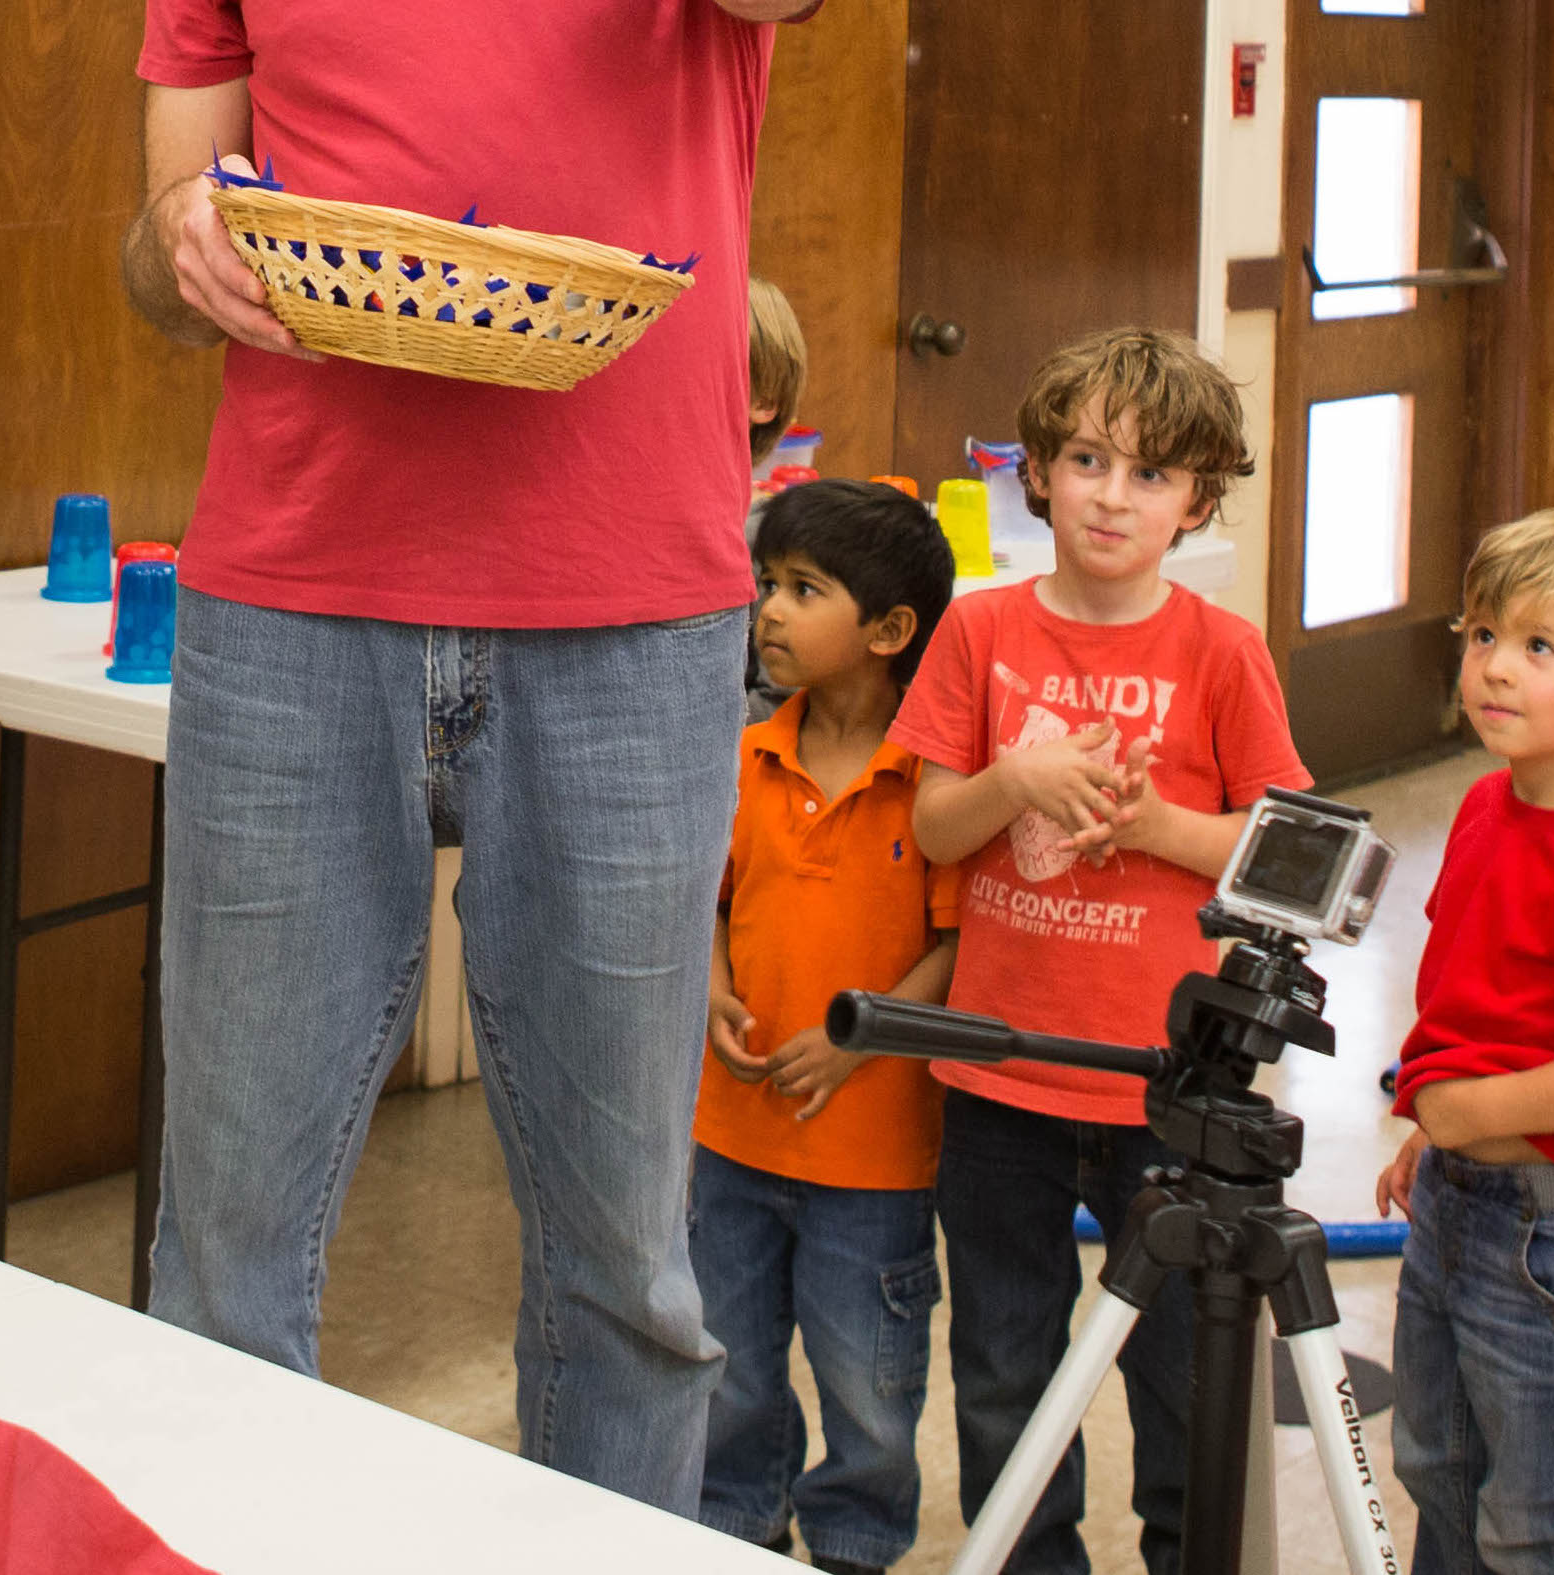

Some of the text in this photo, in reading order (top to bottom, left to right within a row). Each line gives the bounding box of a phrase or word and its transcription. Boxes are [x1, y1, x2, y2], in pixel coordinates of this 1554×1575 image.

[1041, 675, 1178, 744] BAND!
[971, 872, 1009, 906] LIVE
[1010, 889, 1147, 929] CONCERT
[1336, 1376, 1372, 1487] Velbon
[1368, 1499, 1387, 1532] CX
